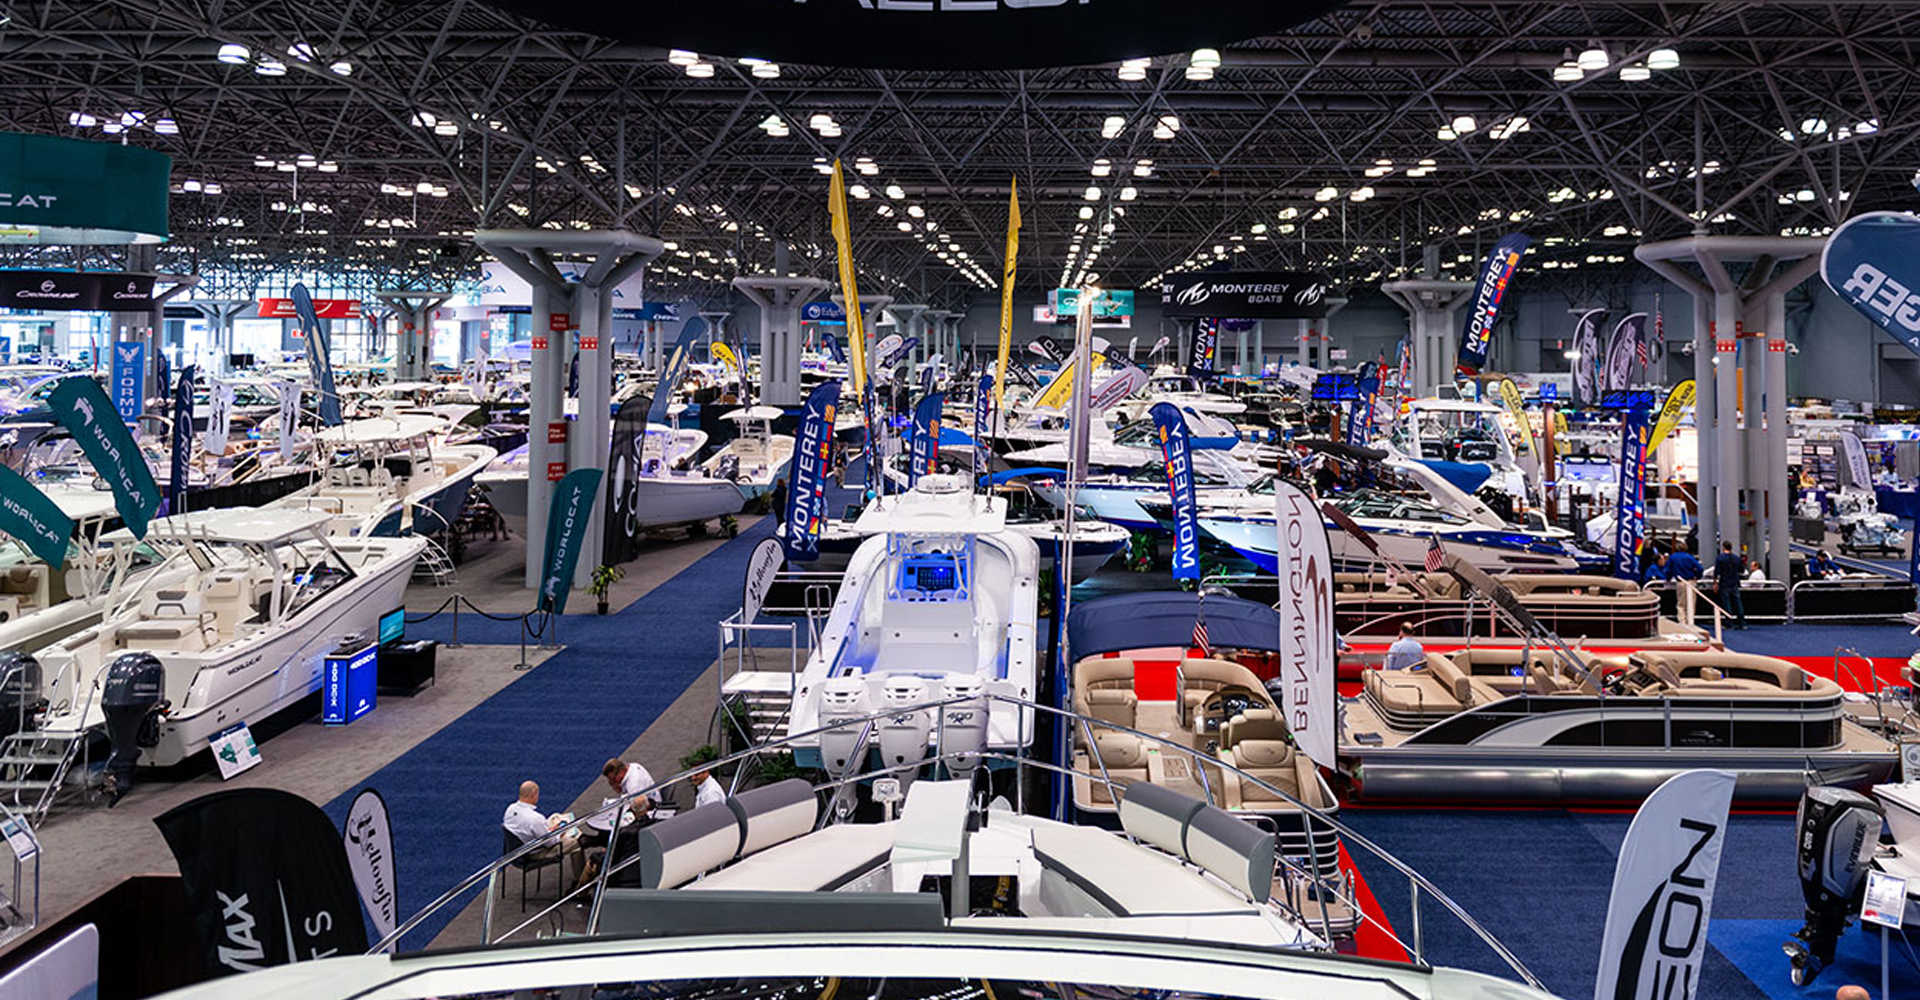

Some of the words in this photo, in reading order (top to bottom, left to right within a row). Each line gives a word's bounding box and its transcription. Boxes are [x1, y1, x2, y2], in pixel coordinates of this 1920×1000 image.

[1211, 284, 1290, 294] MONTEREY
[1247, 294, 1283, 303] BOATS
[1465, 247, 1507, 352] MONTEREY
[1193, 317, 1210, 370] MONT
[120, 367, 136, 418] FORMU
[791, 404, 821, 551] MONTEREY
[1619, 424, 1639, 574] MONTEREY
[554, 486, 583, 573] WORLDCAT
[947, 711, 973, 721] 400
[348, 812, 393, 924] Yellowfin
[1844, 820, 1867, 873] EVINRUDE
